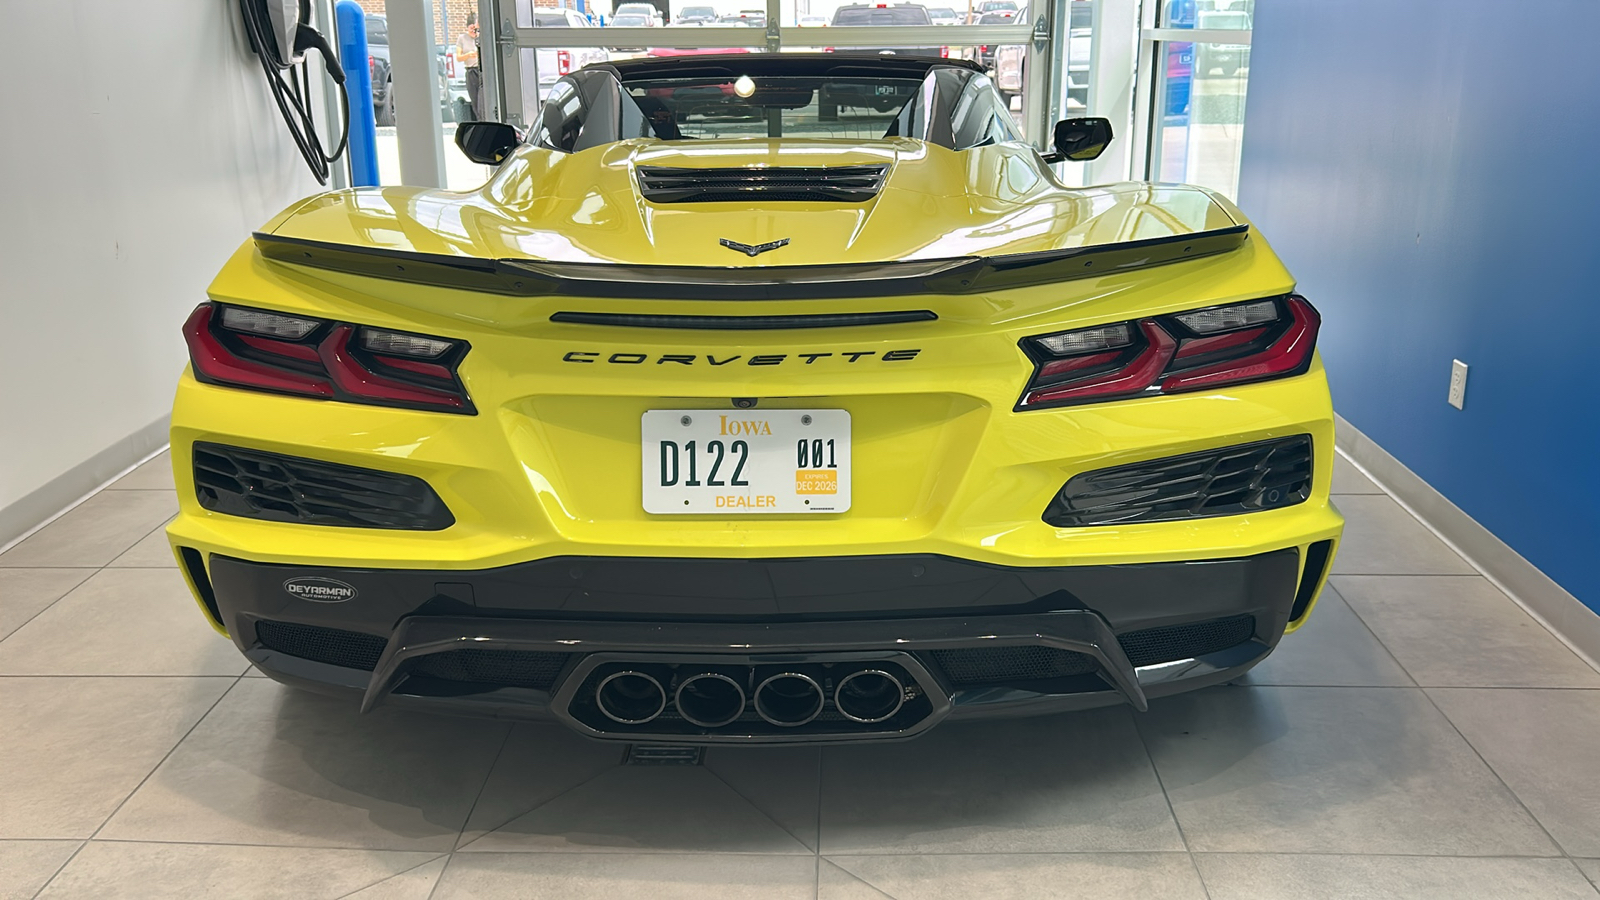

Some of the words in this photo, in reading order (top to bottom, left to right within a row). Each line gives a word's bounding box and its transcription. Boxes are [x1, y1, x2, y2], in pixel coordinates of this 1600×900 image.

[563, 349, 922, 366] CORVETTE
[660, 440, 749, 487] D122
[797, 439, 837, 468] 001
[796, 481, 813, 491] DEC
[815, 481, 837, 491] 2026
[715, 495, 776, 508] DEALER
[288, 584, 351, 596] DEYARMAN
